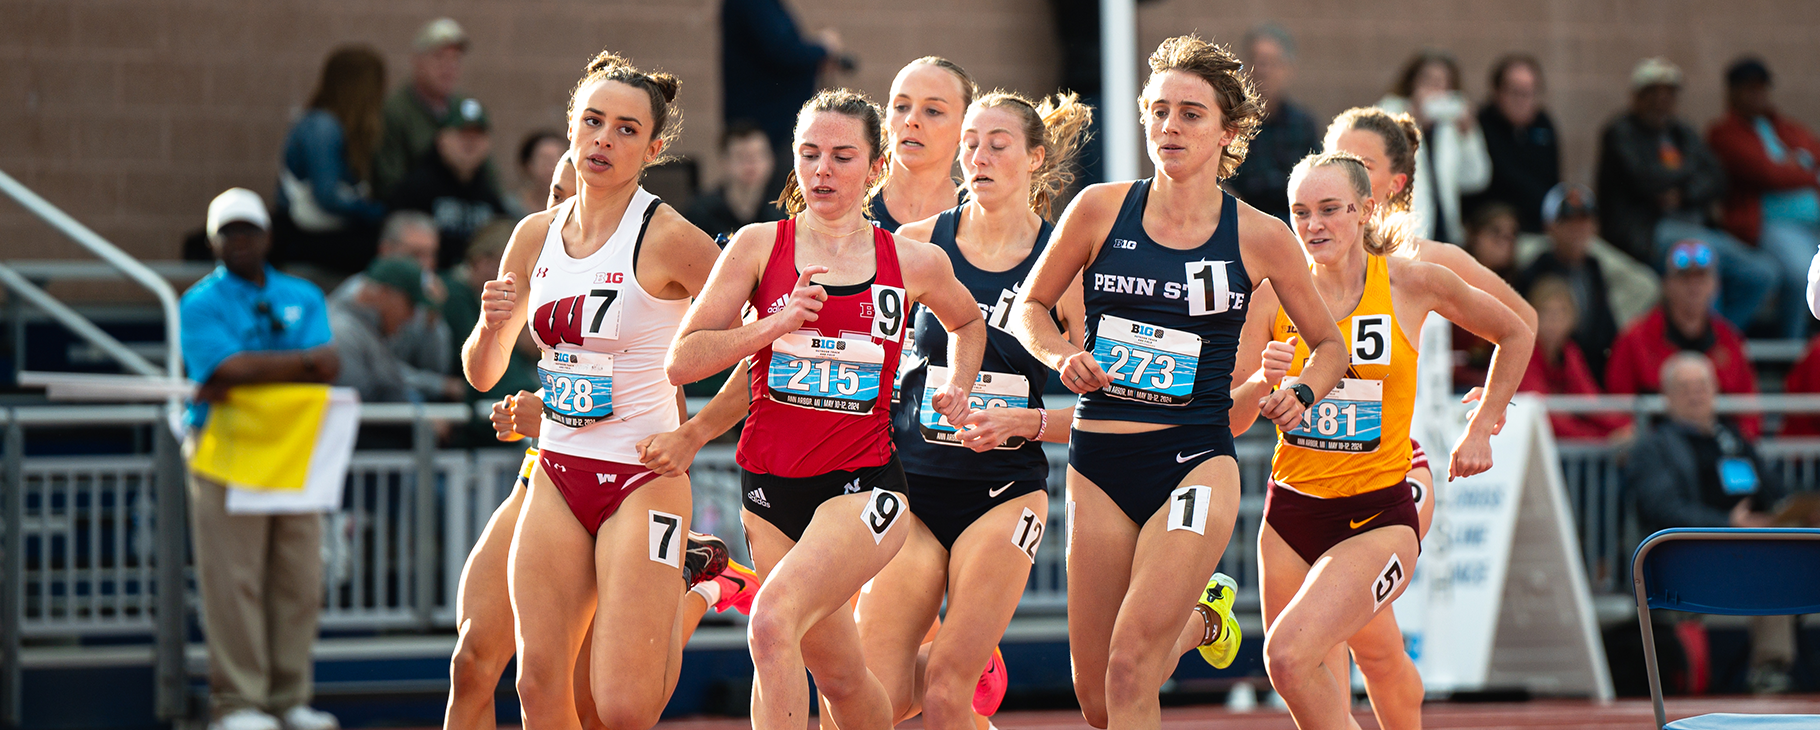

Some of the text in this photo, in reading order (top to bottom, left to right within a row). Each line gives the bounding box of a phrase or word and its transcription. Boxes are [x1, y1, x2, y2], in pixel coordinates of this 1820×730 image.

[1094, 273, 1157, 297] PENN
[1193, 264, 1216, 312] 1
[589, 289, 618, 334] 7
[878, 288, 902, 337] 9
[1356, 317, 1385, 361] 5
[786, 359, 860, 397] 215
[1106, 344, 1177, 390] 273
[546, 373, 594, 413] 328
[1302, 401, 1358, 437] 181
[596, 473, 617, 485] W
[843, 477, 861, 495] N
[869, 492, 900, 535] 9
[1177, 487, 1197, 528] 1
[652, 513, 678, 560] 7
[1018, 513, 1043, 560] 12
[1376, 560, 1403, 603] 5
